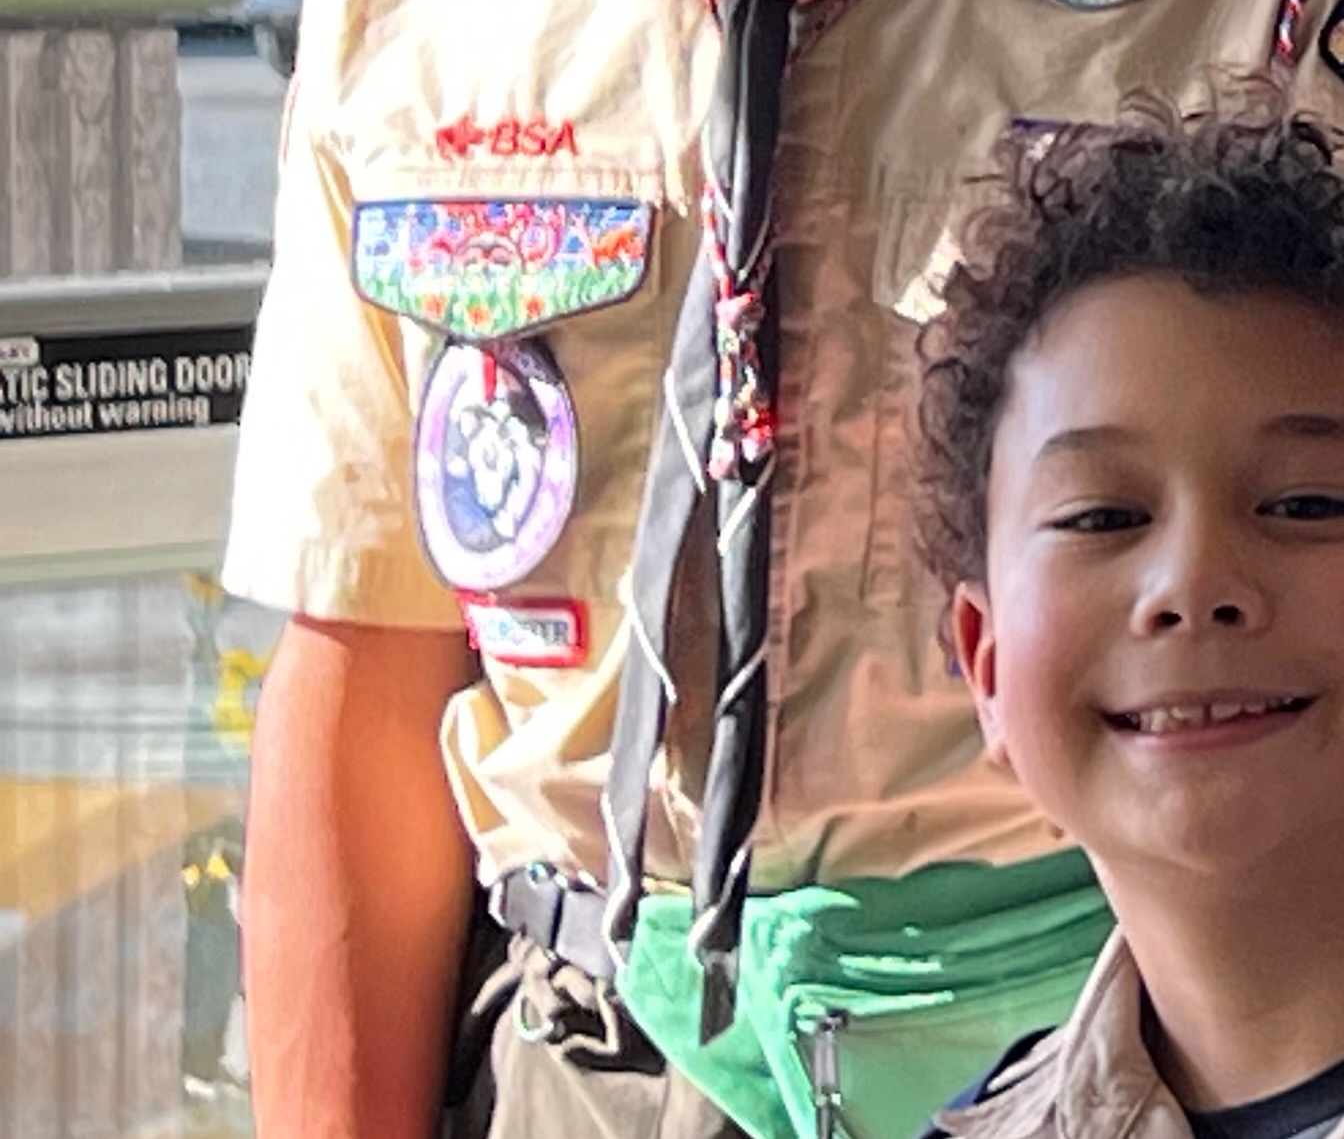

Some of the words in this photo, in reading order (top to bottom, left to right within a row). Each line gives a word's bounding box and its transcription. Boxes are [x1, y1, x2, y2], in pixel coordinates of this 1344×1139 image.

[491, 118, 579, 155] BSA
[0, 365, 49, 405] TIC
[55, 356, 168, 402] SLIDING
[0, 396, 94, 435] without
[98, 392, 211, 428] warning
